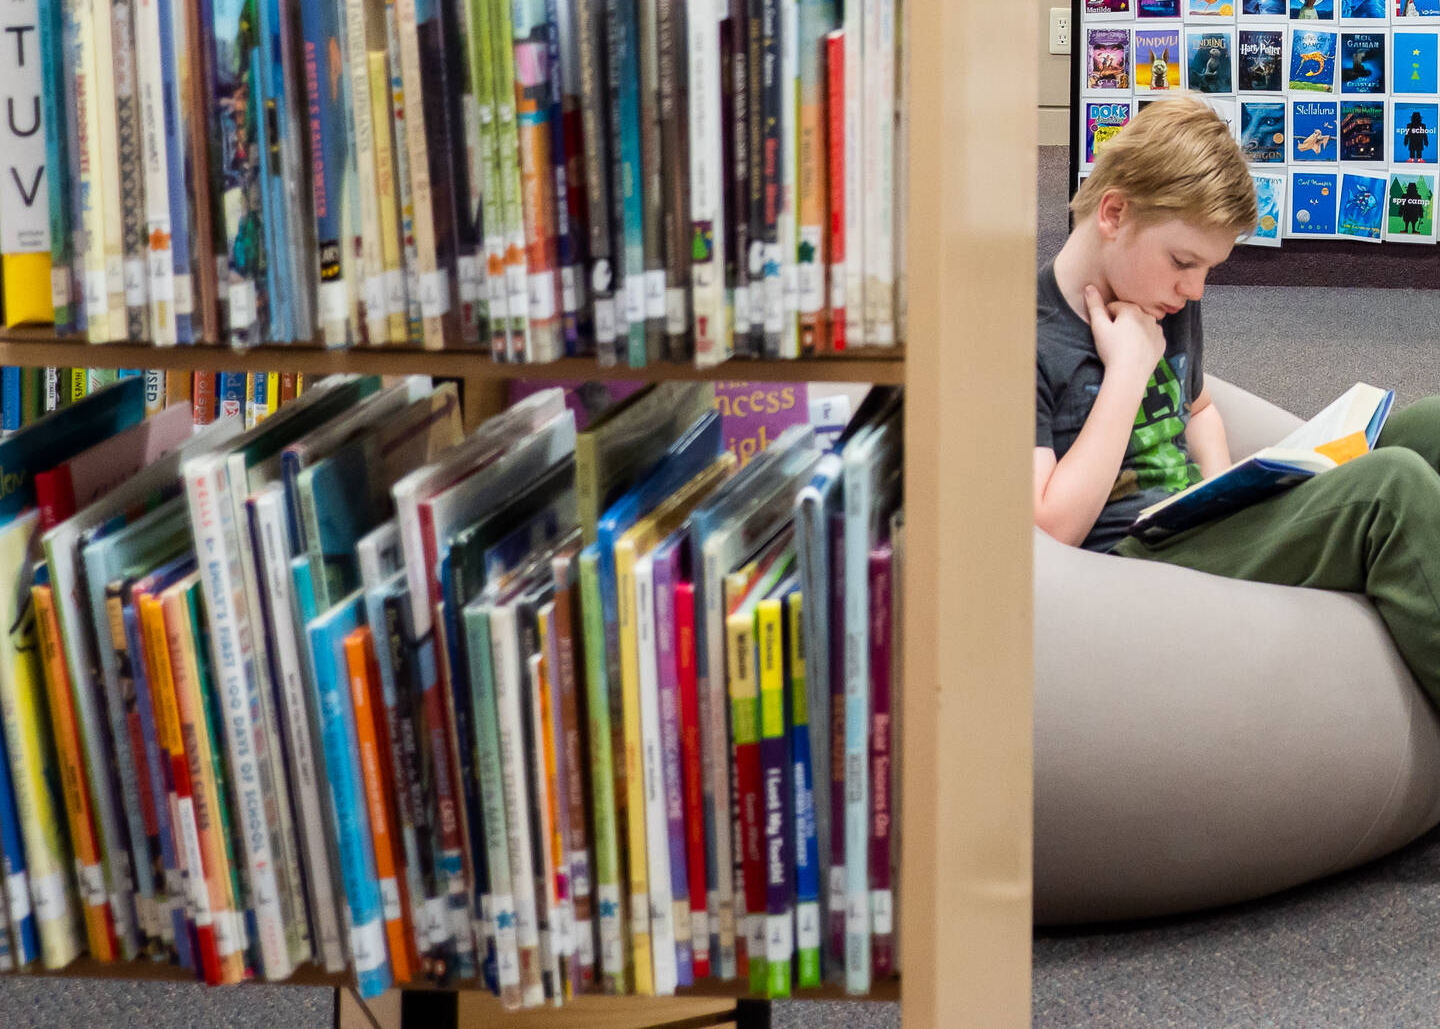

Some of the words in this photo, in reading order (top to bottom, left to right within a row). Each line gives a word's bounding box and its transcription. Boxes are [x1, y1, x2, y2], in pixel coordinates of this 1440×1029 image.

[1086, 6, 1112, 14] Matilda
[5, 25, 35, 66] T
[1136, 35, 1178, 47] PINDULI
[1240, 44, 1258, 56] Harry
[1259, 44, 1281, 56] Potter
[1090, 104, 1129, 119] DORK
[1295, 103, 1335, 116] Stellaluna
[8, 96, 41, 137] U
[1396, 127, 1409, 136] spy
[1411, 125, 1437, 134] school
[10, 165, 44, 207] V
[1392, 198, 1406, 207] spy
[1407, 198, 1430, 207] camp
